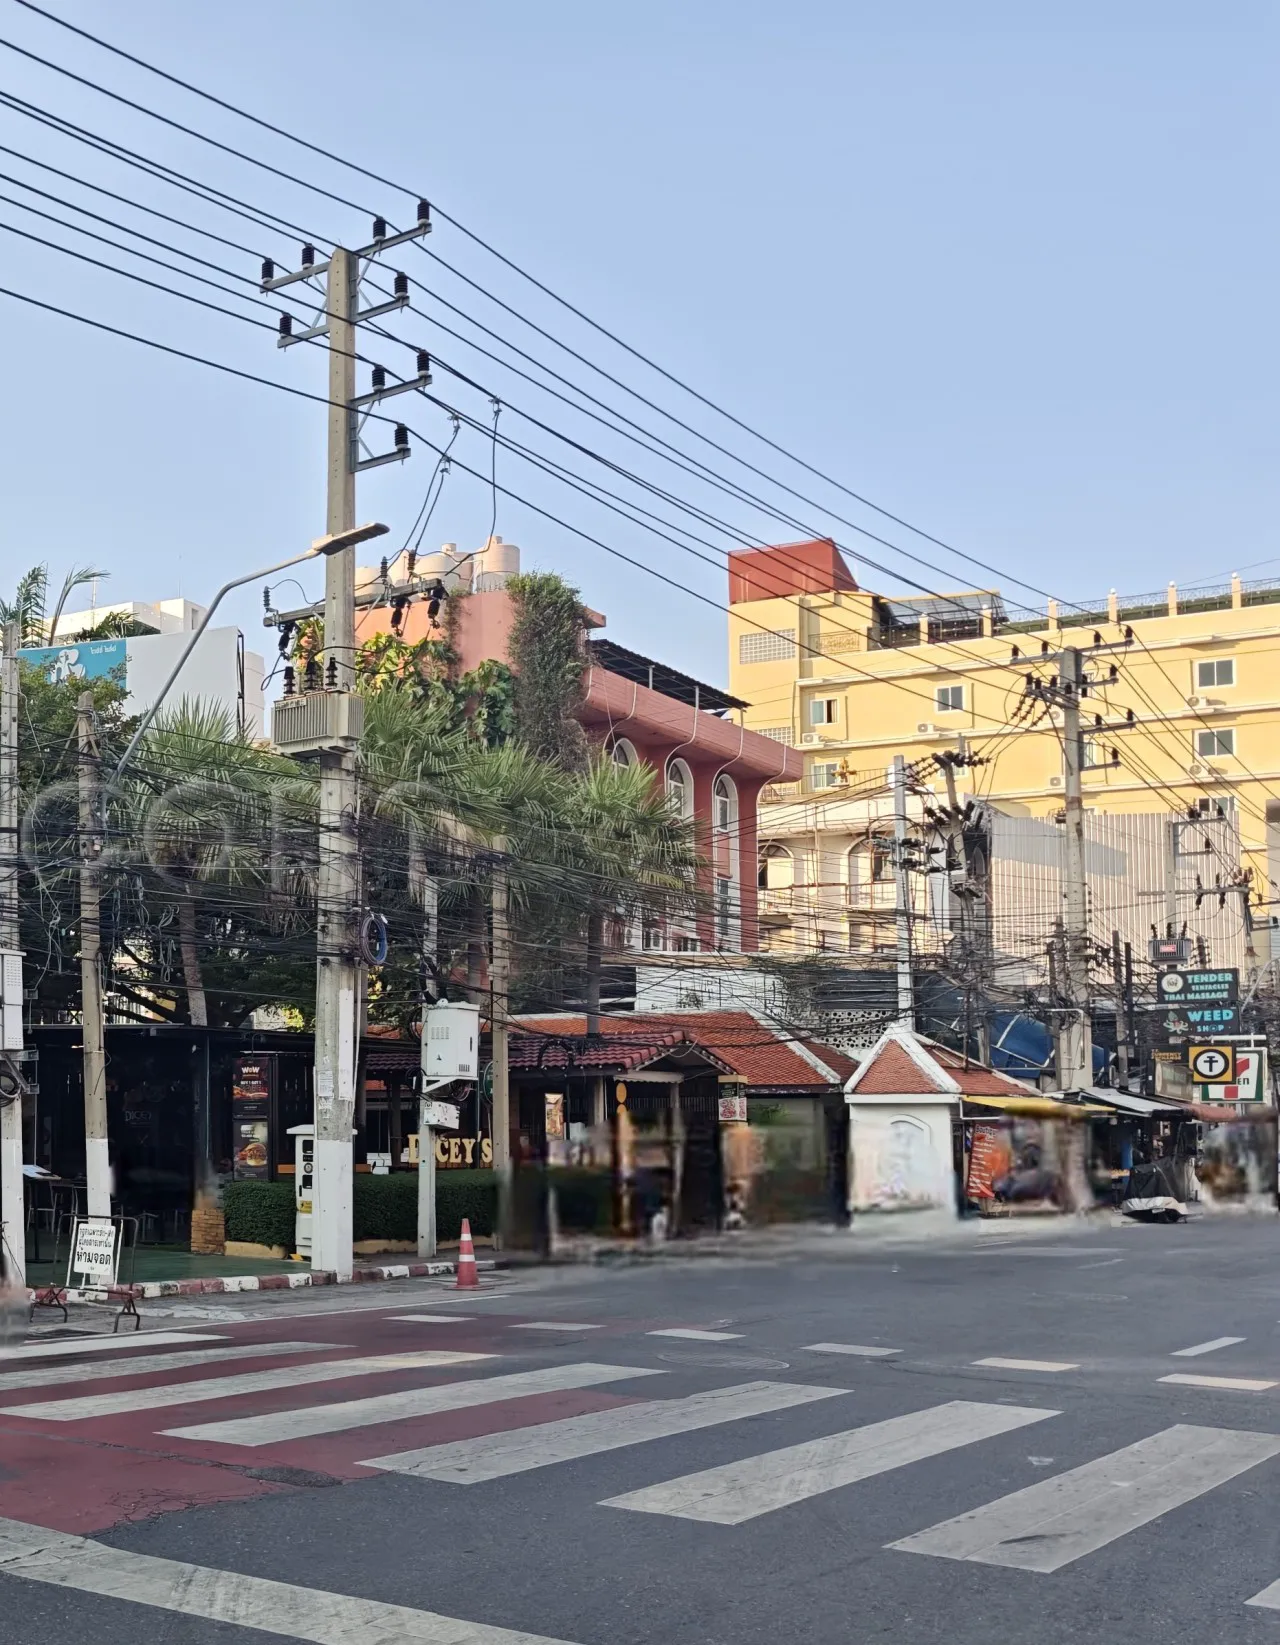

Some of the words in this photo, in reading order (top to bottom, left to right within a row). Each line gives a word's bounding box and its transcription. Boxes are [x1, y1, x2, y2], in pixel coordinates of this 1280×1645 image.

[1186, 973, 1233, 983] TENDER
[1191, 983, 1229, 991] TENTACLES
[1187, 991, 1228, 1000] MASSAGE
[1187, 1009, 1234, 1022] WEED
[1197, 1025, 1224, 1033] SHOP
[407, 1131, 492, 1164] DCEY'S
[76, 1247, 111, 1265] ห้ามจอด
